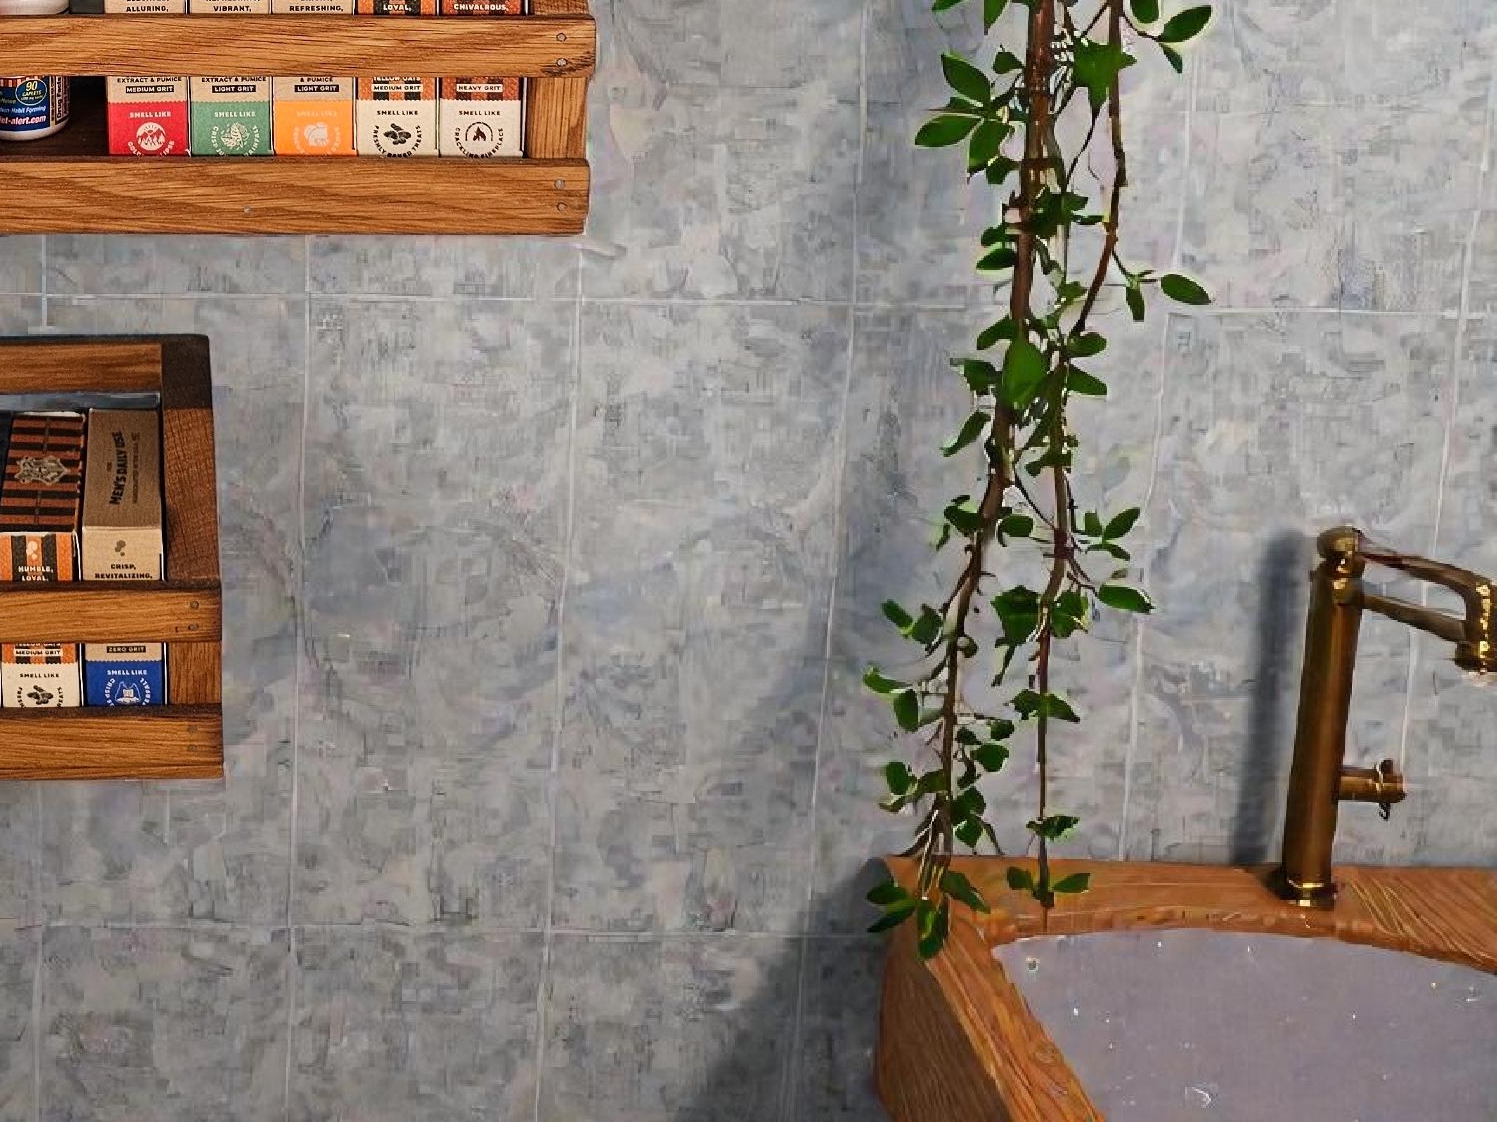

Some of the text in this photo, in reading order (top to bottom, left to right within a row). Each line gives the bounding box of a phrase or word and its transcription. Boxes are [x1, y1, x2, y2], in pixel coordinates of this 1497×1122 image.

[25, 81, 38, 91] 90
[26, 105, 46, 113] Forming
[109, 473, 126, 505] MEN'S
